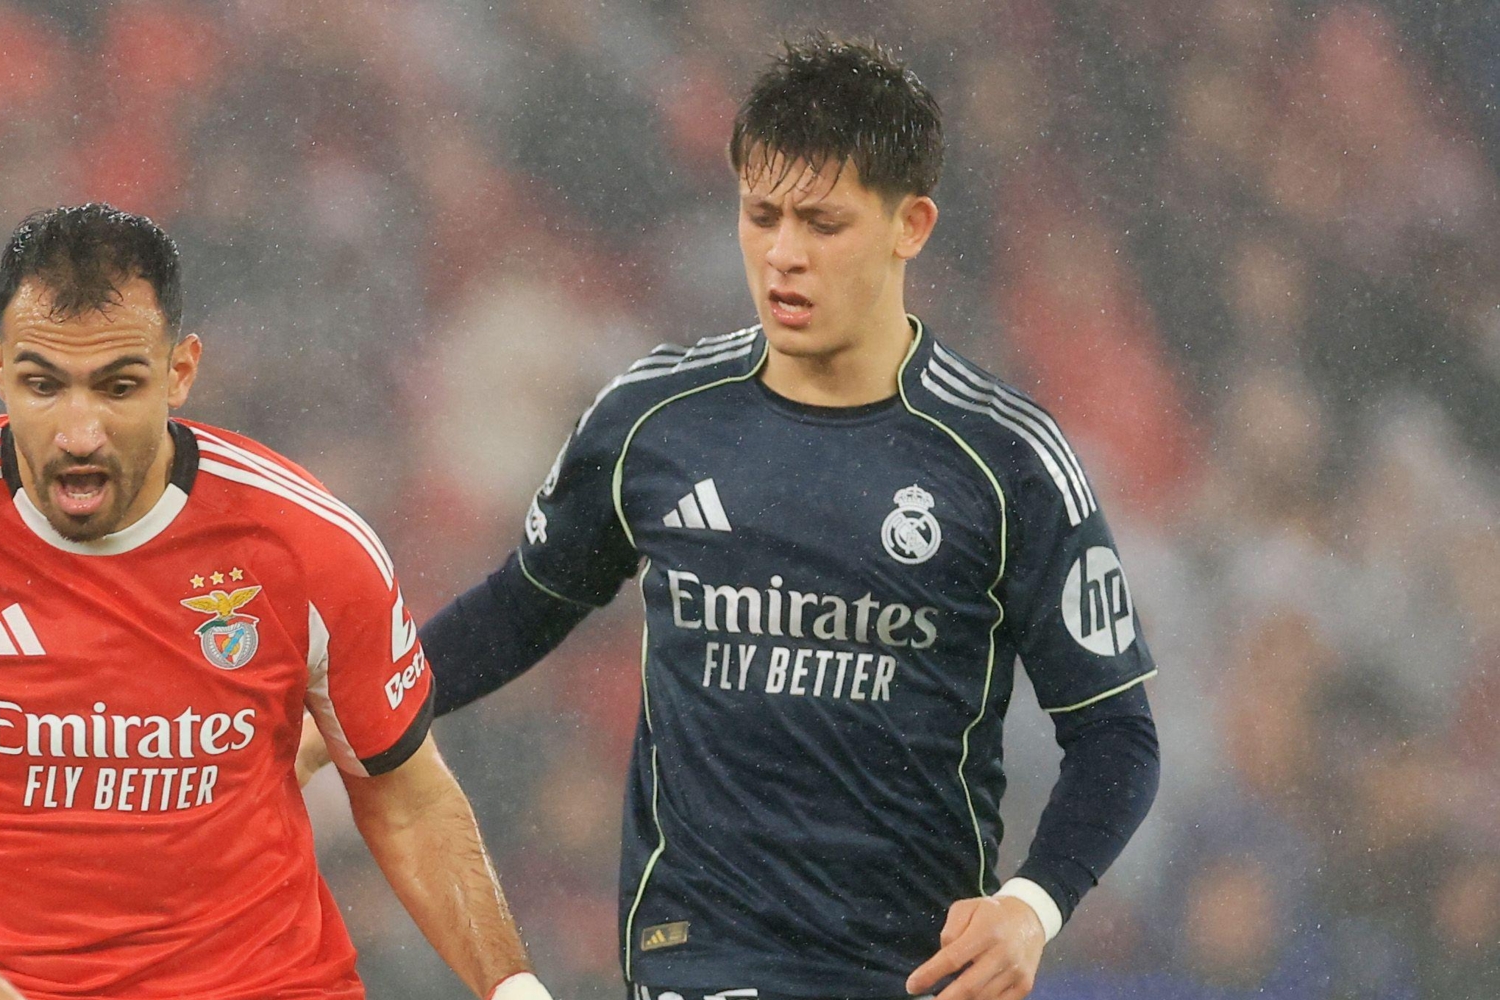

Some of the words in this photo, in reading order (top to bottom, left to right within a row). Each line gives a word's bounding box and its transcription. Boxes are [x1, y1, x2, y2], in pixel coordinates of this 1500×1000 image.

[666, 568, 939, 649] Emirates
[702, 641, 758, 690] FLY
[765, 646, 897, 702] BETTER
[22, 765, 84, 809] FLY
[94, 764, 219, 812] BETTER
